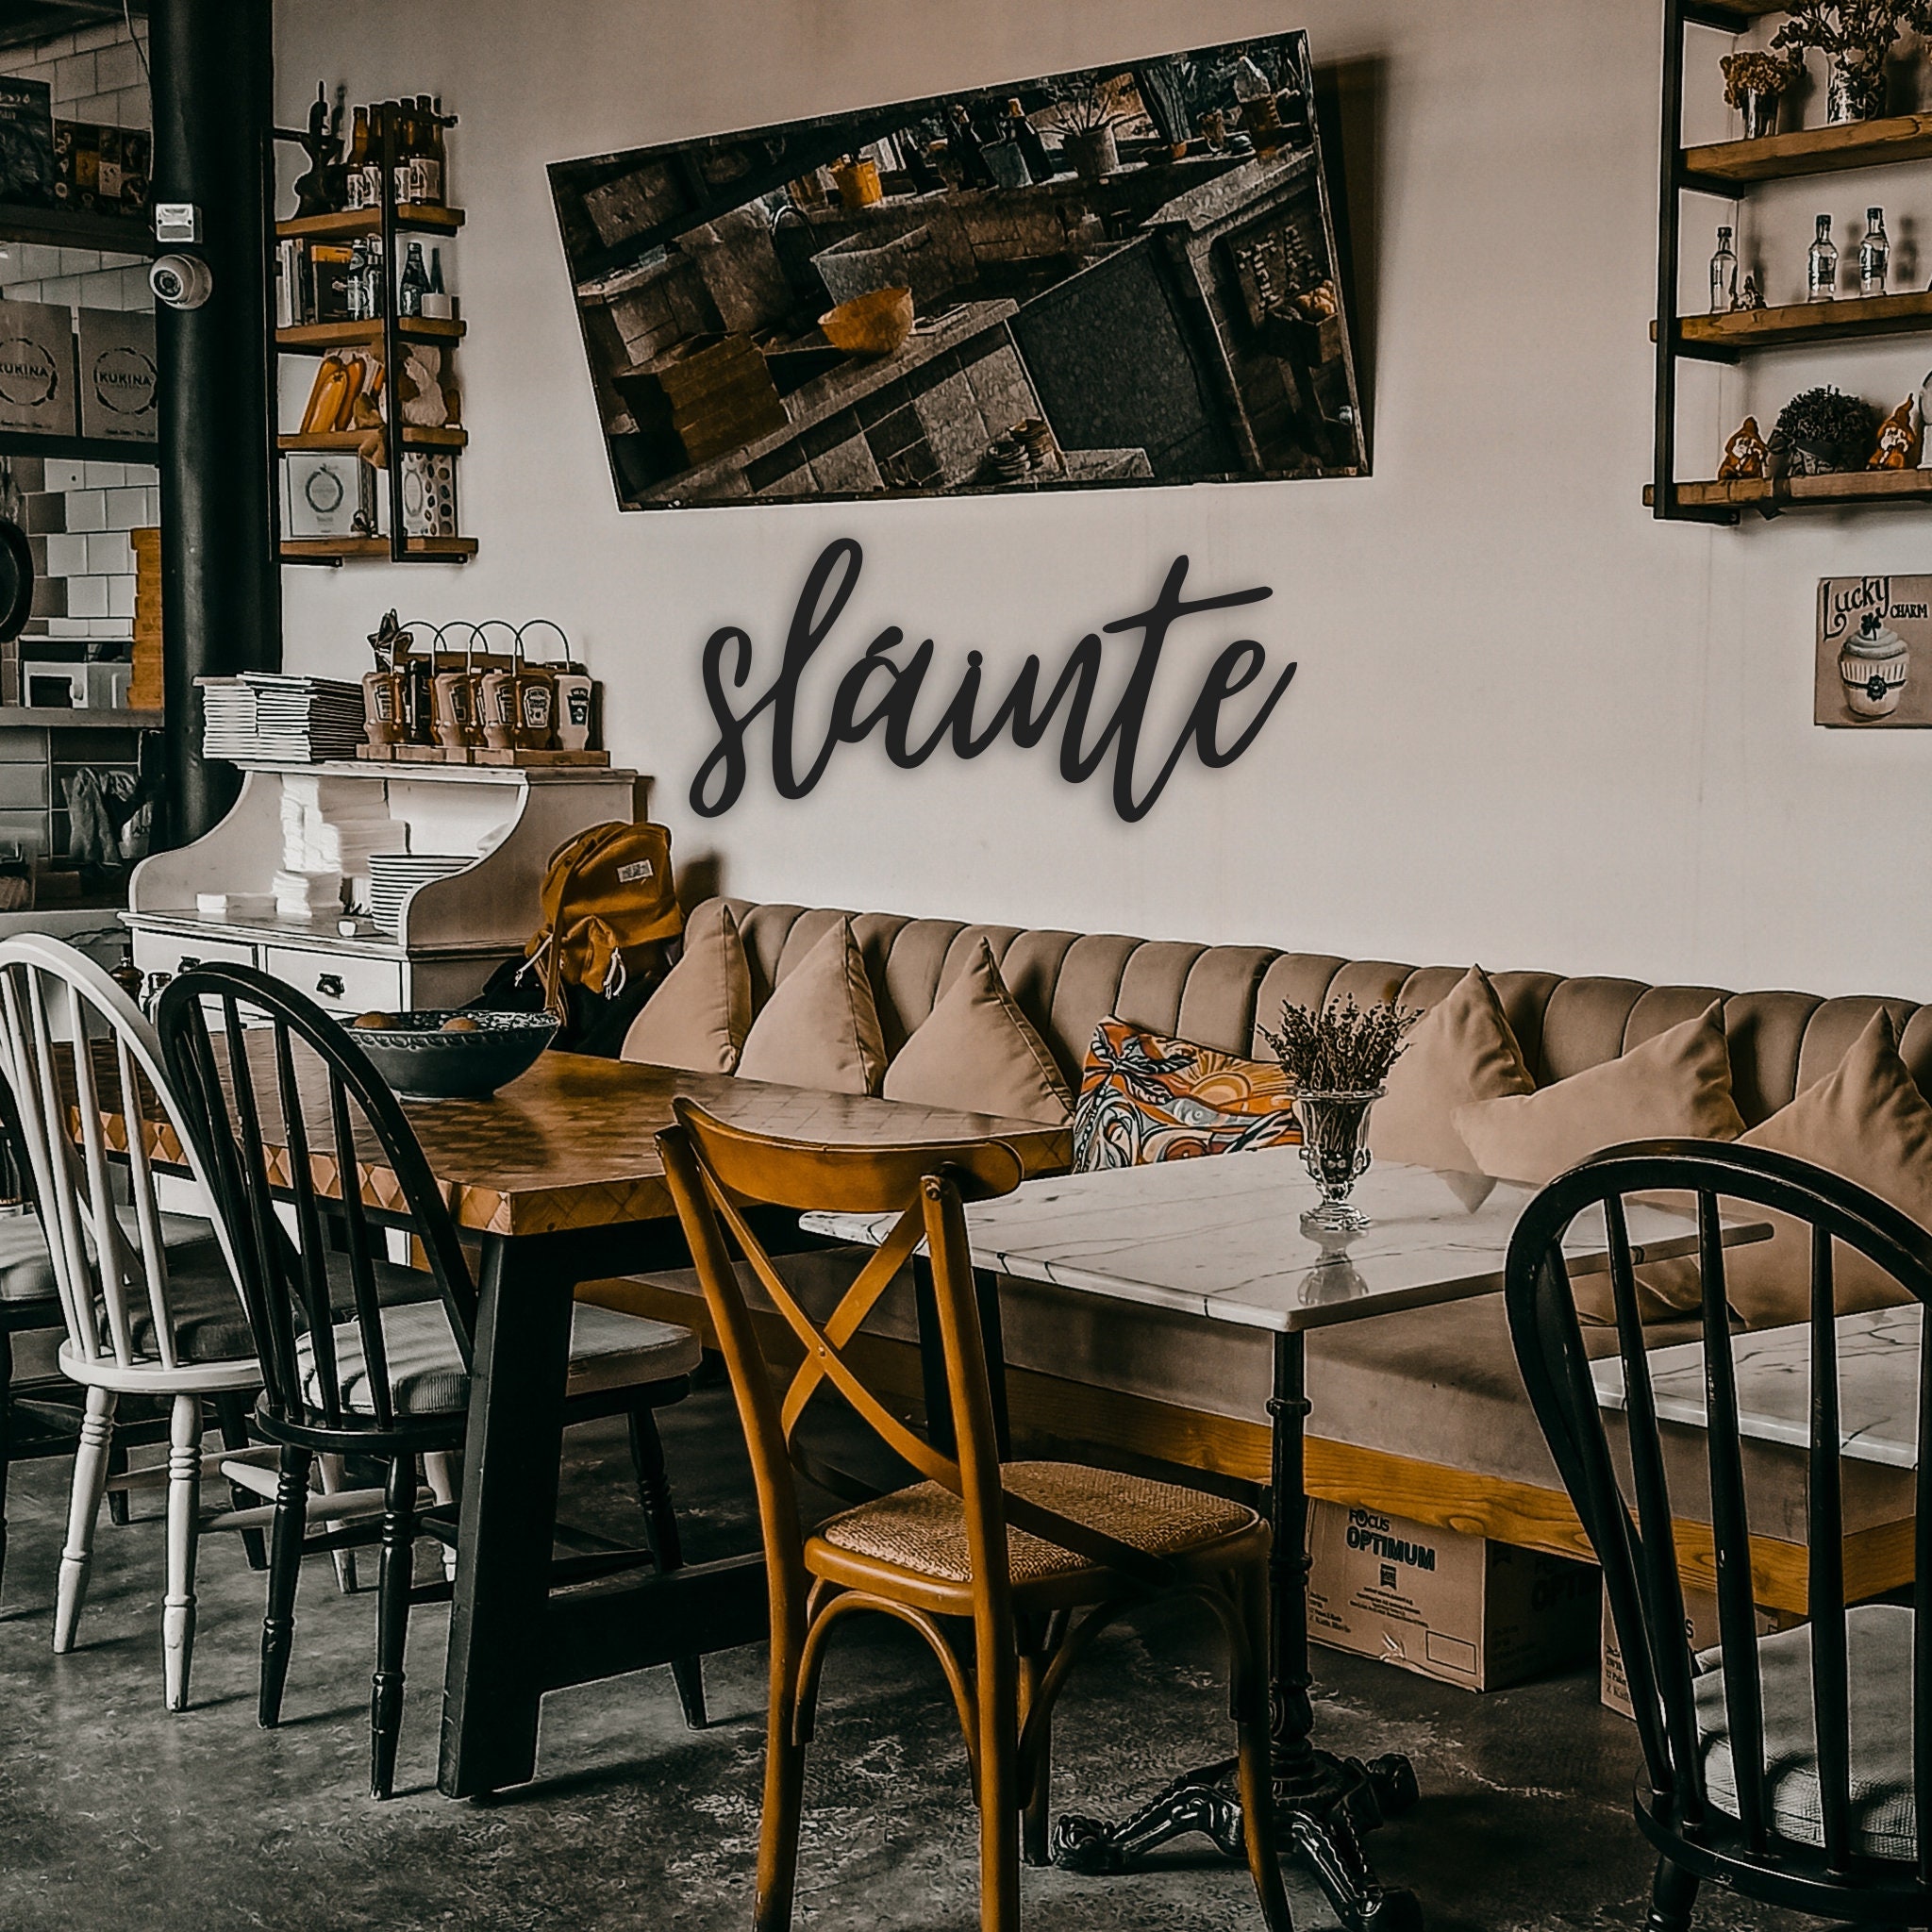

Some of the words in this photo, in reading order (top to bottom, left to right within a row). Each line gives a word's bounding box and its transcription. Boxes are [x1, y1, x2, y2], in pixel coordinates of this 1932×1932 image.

[99, 372, 152, 387] KUKINA
[1822, 576, 1890, 642] Lucky
[1890, 603, 1928, 619] CHARM
[1348, 1508, 1391, 1532] FOCUS
[1346, 1525, 1436, 1572] OPTIMUM
